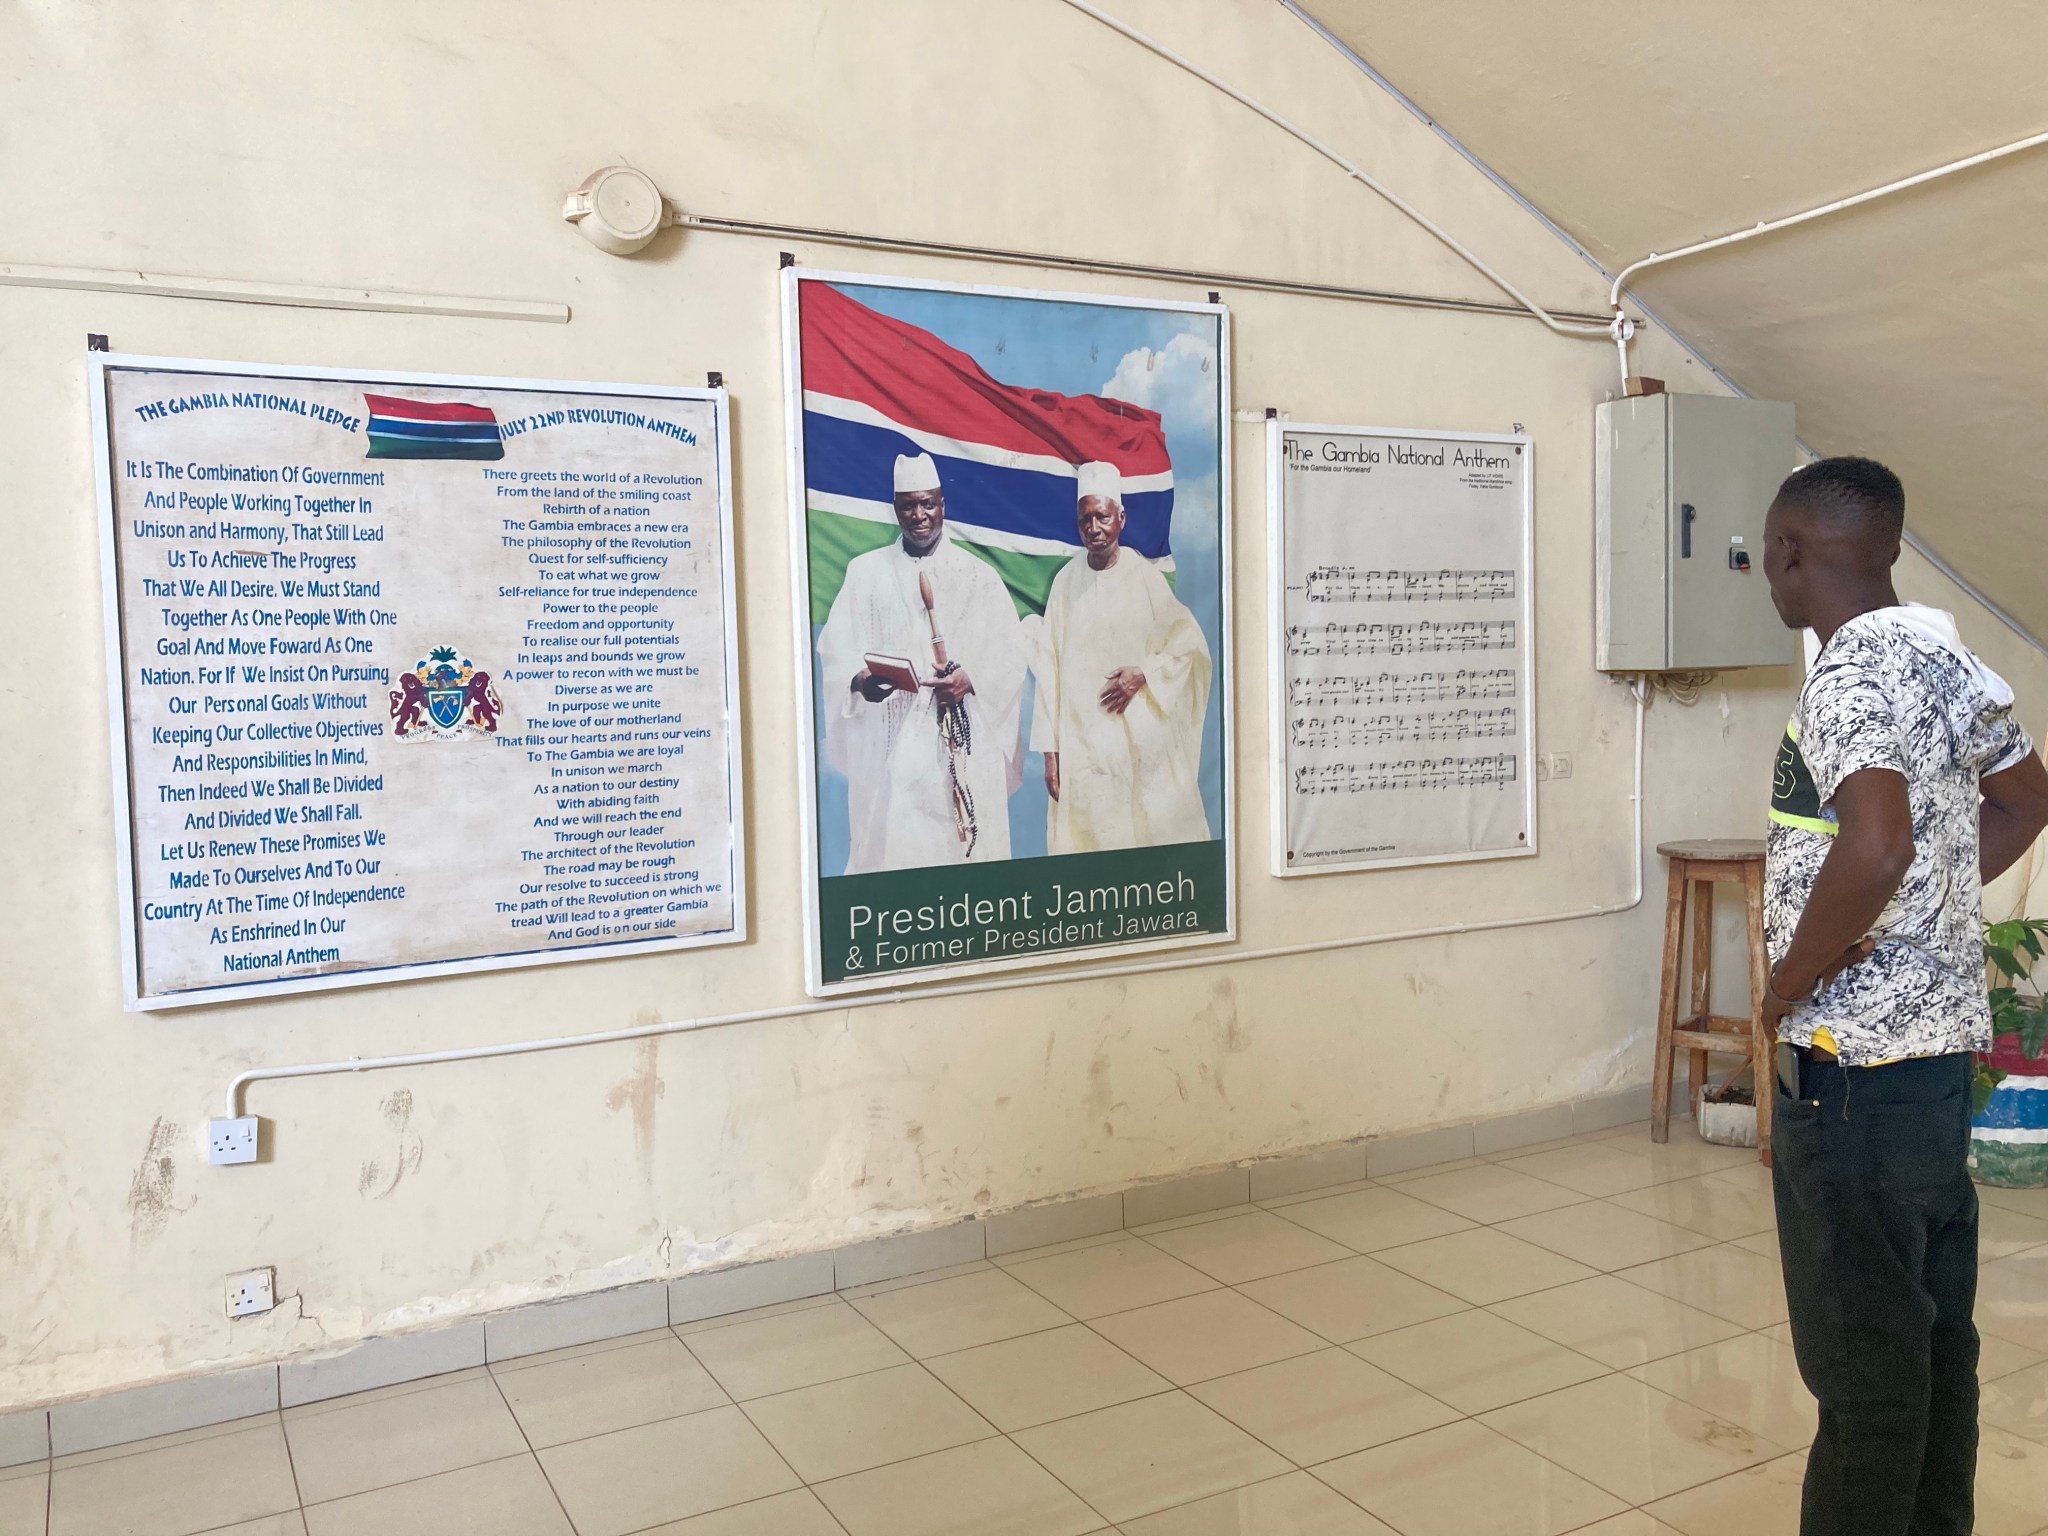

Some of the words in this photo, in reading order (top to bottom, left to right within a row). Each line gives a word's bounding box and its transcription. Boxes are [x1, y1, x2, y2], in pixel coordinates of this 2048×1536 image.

[135, 401, 168, 422] THE
[169, 393, 228, 413] GAMBIA
[232, 392, 306, 416] NATIONAL
[310, 404, 360, 433] PLEDGE
[500, 418, 526, 440] JULY
[529, 411, 564, 430] 22ND
[568, 409, 645, 428] REVOLUTION
[647, 418, 697, 446] ANTHEM
[1284, 440, 1314, 461] The
[1322, 441, 1379, 463] Gambia
[1388, 444, 1444, 465] National
[1452, 447, 1509, 468] Anthem
[126, 460, 137, 477] It
[140, 460, 152, 478] Is
[155, 461, 183, 479] The
[187, 462, 278, 482] Combination
[282, 466, 299, 482] Of
[302, 466, 384, 485] Government
[482, 468, 517, 479] There
[520, 471, 556, 483] greets
[560, 471, 579, 481] the
[582, 472, 616, 482] world
[619, 472, 630, 482] of
[633, 475, 640, 483] a
[643, 473, 702, 485] Revolution
[1311, 464, 1332, 472] Gambia
[144, 490, 175, 508] And
[179, 491, 227, 514] People
[231, 493, 291, 517] Working
[294, 494, 355, 517] Together
[359, 497, 371, 513] In
[543, 503, 586, 514] Rebirth
[588, 504, 601, 514] of
[613, 505, 650, 516] nation
[134, 520, 185, 538] Unison
[189, 521, 216, 538] and
[220, 521, 288, 545] Harmony,
[291, 523, 322, 540] That
[326, 523, 348, 540] Still
[353, 524, 383, 541] Lead
[502, 519, 525, 530] The
[528, 519, 574, 530] Gambia
[576, 520, 631, 531] embraces
[634, 524, 641, 532] a
[644, 524, 668, 532] new
[671, 524, 688, 532] era
[498, 586, 570, 597] Self-reliance
[572, 586, 589, 596] for
[592, 587, 616, 596] true
[618, 586, 697, 599] independence
[161, 608, 228, 631] Together
[230, 609, 248, 626] As
[252, 609, 282, 626] One
[284, 608, 330, 630] People
[333, 608, 366, 625] With
[370, 609, 397, 625] One
[527, 619, 579, 629] Freedom
[582, 619, 604, 629] and
[607, 618, 674, 631] opportunity
[518, 653, 529, 663] In
[532, 652, 562, 665] leaps
[566, 651, 588, 662] and
[591, 651, 633, 661] bounds
[636, 652, 653, 660] we
[656, 652, 685, 663] grow
[140, 667, 194, 685] Nation.
[198, 666, 222, 684] For
[225, 665, 236, 683] If
[241, 665, 265, 683] We
[269, 665, 304, 682] Insist
[307, 665, 328, 681] On
[332, 664, 389, 685] Pursuing
[555, 684, 597, 695] Diverse
[600, 685, 612, 694] as
[615, 685, 632, 693] we
[635, 684, 653, 692] are
[168, 696, 197, 713] Our
[204, 694, 267, 713] Personal
[271, 693, 308, 710] Goals
[312, 692, 367, 709] Without
[172, 754, 202, 772] And
[207, 749, 311, 775] Responsibilities
[315, 749, 328, 765] In
[332, 747, 368, 765] Mind,
[551, 767, 562, 777] In
[565, 765, 604, 776] unison
[627, 761, 662, 773] march
[556, 798, 585, 809] With
[588, 796, 631, 808] abiding
[633, 793, 659, 804] faith
[184, 811, 214, 830] And
[218, 808, 271, 828] Divided
[274, 806, 298, 824] We
[300, 804, 332, 823] Shall
[336, 803, 362, 820] Fall.
[161, 843, 183, 860] Let
[187, 841, 204, 858] Us
[209, 840, 257, 857] Renew
[259, 837, 300, 853] These
[303, 831, 360, 851] Promises
[363, 829, 385, 846] We
[553, 829, 604, 842] Through
[606, 829, 626, 838] our
[629, 825, 664, 836] leader
[1303, 850, 1324, 858] Copyright
[144, 900, 203, 922] Country
[206, 898, 223, 915] At
[226, 896, 252, 913] The
[255, 893, 289, 911] Time
[292, 890, 310, 907] Of
[312, 885, 405, 908] Independence
[495, 902, 518, 912] The
[520, 898, 548, 913] path
[551, 896, 564, 907] of
[565, 895, 585, 906] the
[588, 890, 650, 904] Revolution
[652, 889, 666, 897] on
[669, 884, 702, 895] which
[705, 884, 721, 892] we
[850, 891, 1032, 939] President
[1046, 871, 1194, 916] Jammeh
[547, 928, 572, 940] And
[575, 924, 600, 937] God
[602, 924, 611, 934] is
[614, 924, 630, 935] on
[632, 922, 652, 931] our
[654, 918, 677, 929] side
[846, 946, 864, 969] &
[876, 937, 974, 965] Former
[985, 919, 1103, 951] President
[1112, 911, 1198, 935] Jawara
[224, 950, 282, 972] National
[286, 947, 340, 965] Anthem
